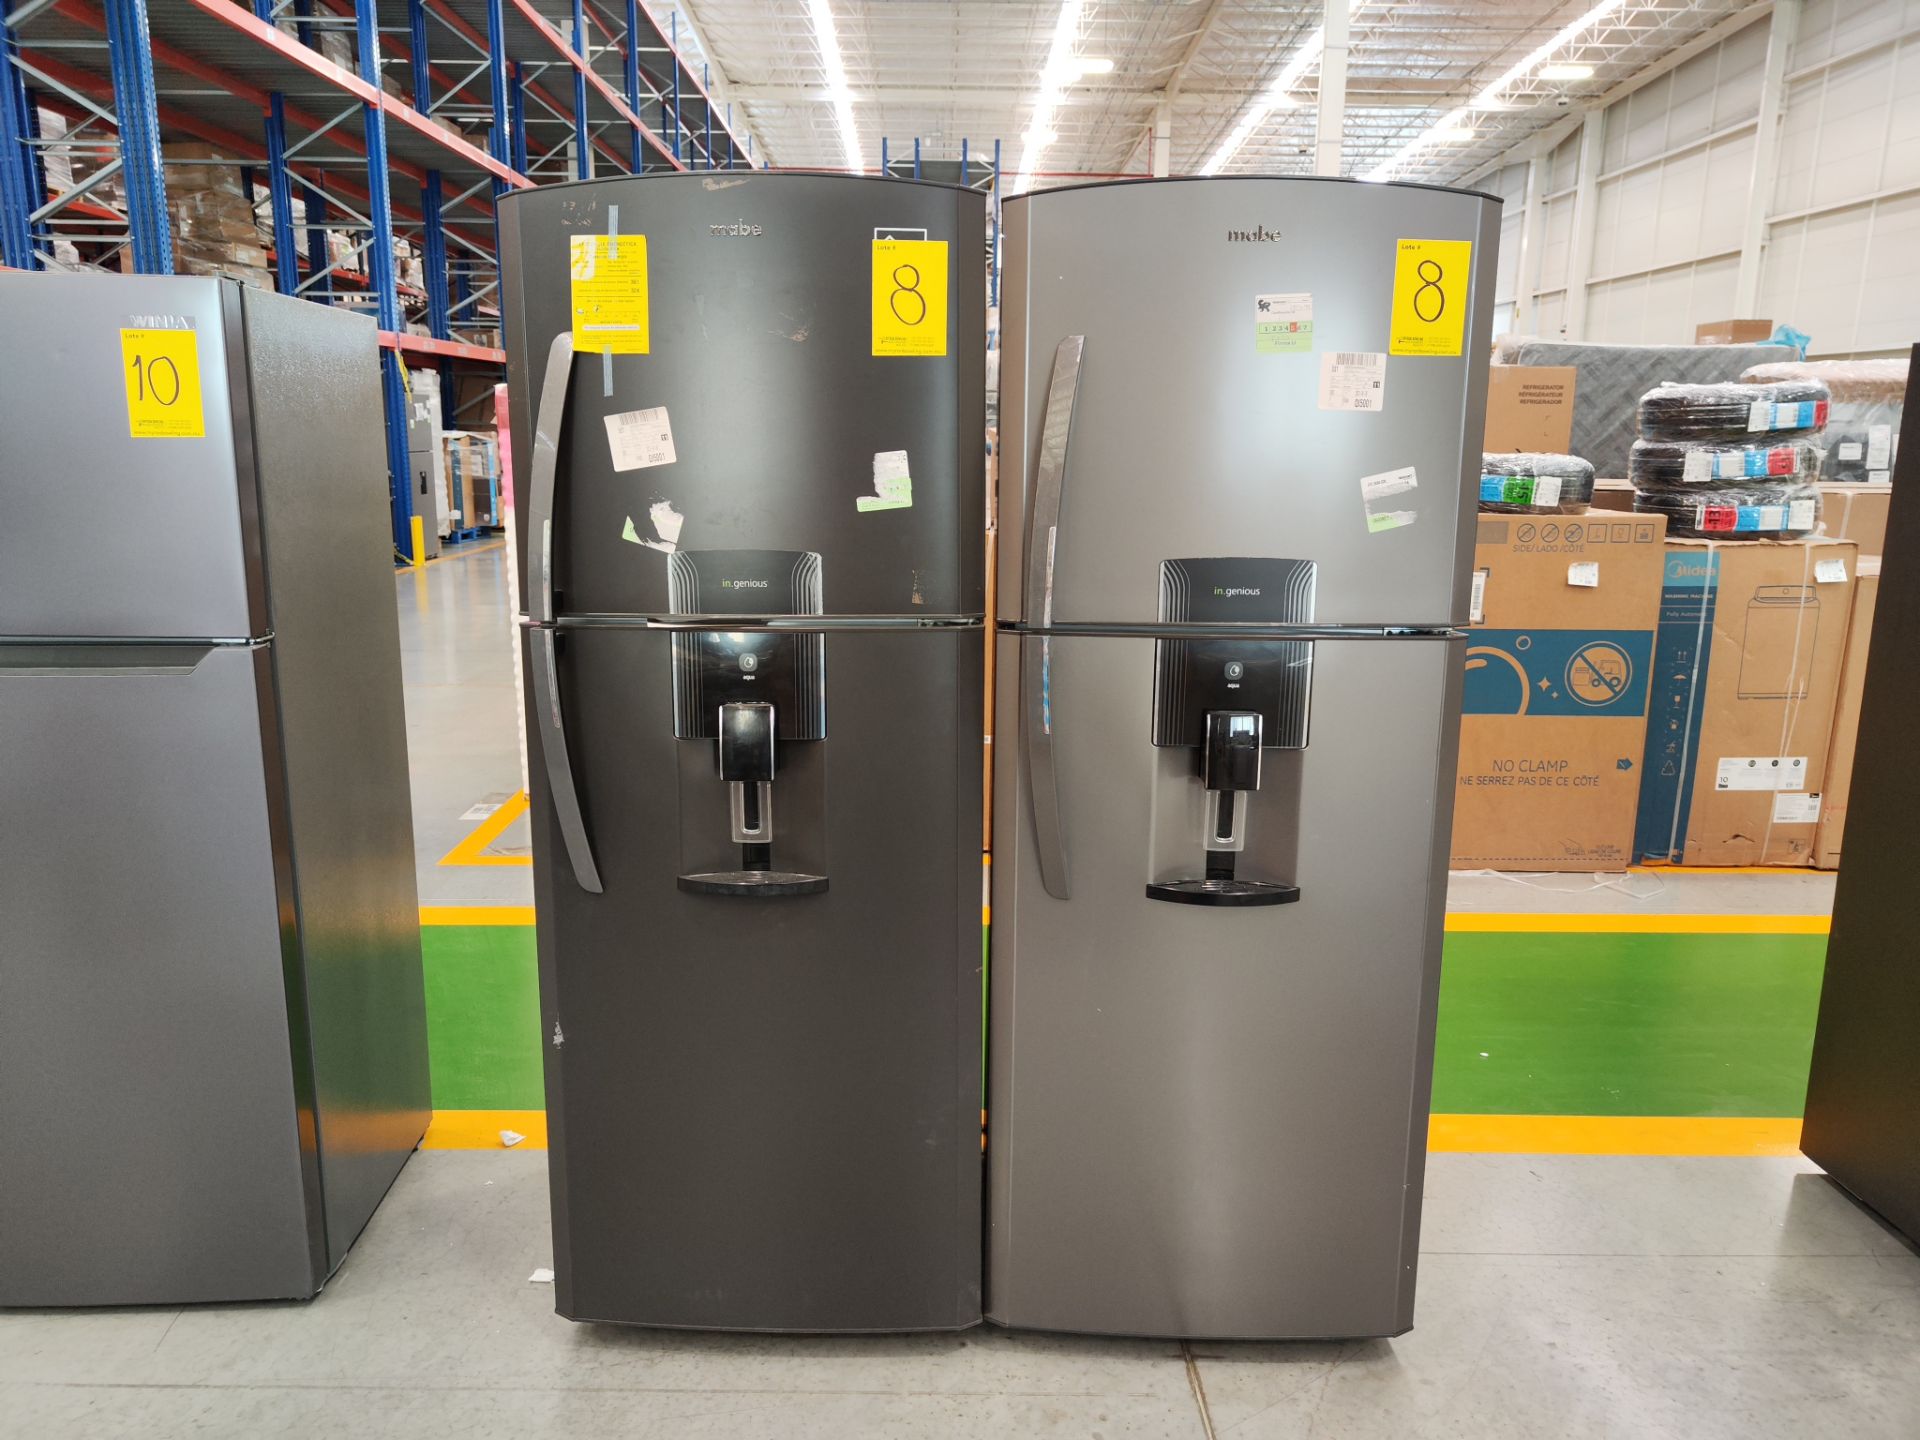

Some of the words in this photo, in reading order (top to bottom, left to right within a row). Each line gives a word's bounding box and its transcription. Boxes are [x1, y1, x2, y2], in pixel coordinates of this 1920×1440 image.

[709, 218, 762, 237] mabe
[1228, 224, 1281, 242] mabe
[890, 264, 926, 326] 8
[1414, 260, 1445, 322] 8
[132, 355, 179, 406] 10
[722, 579, 768, 590] in.genious
[1214, 586, 1260, 597] in.genious
[1492, 760, 1515, 772] NO
[1519, 760, 1568, 773] CLAMP
[1460, 775, 1473, 785] NE
[1476, 775, 1515, 786] SERREZ
[1518, 776, 1536, 786] PAS
[1539, 777, 1552, 786] DE
[1556, 777, 1569, 786] CE
[1573, 775, 1599, 787] CÔTÉ
